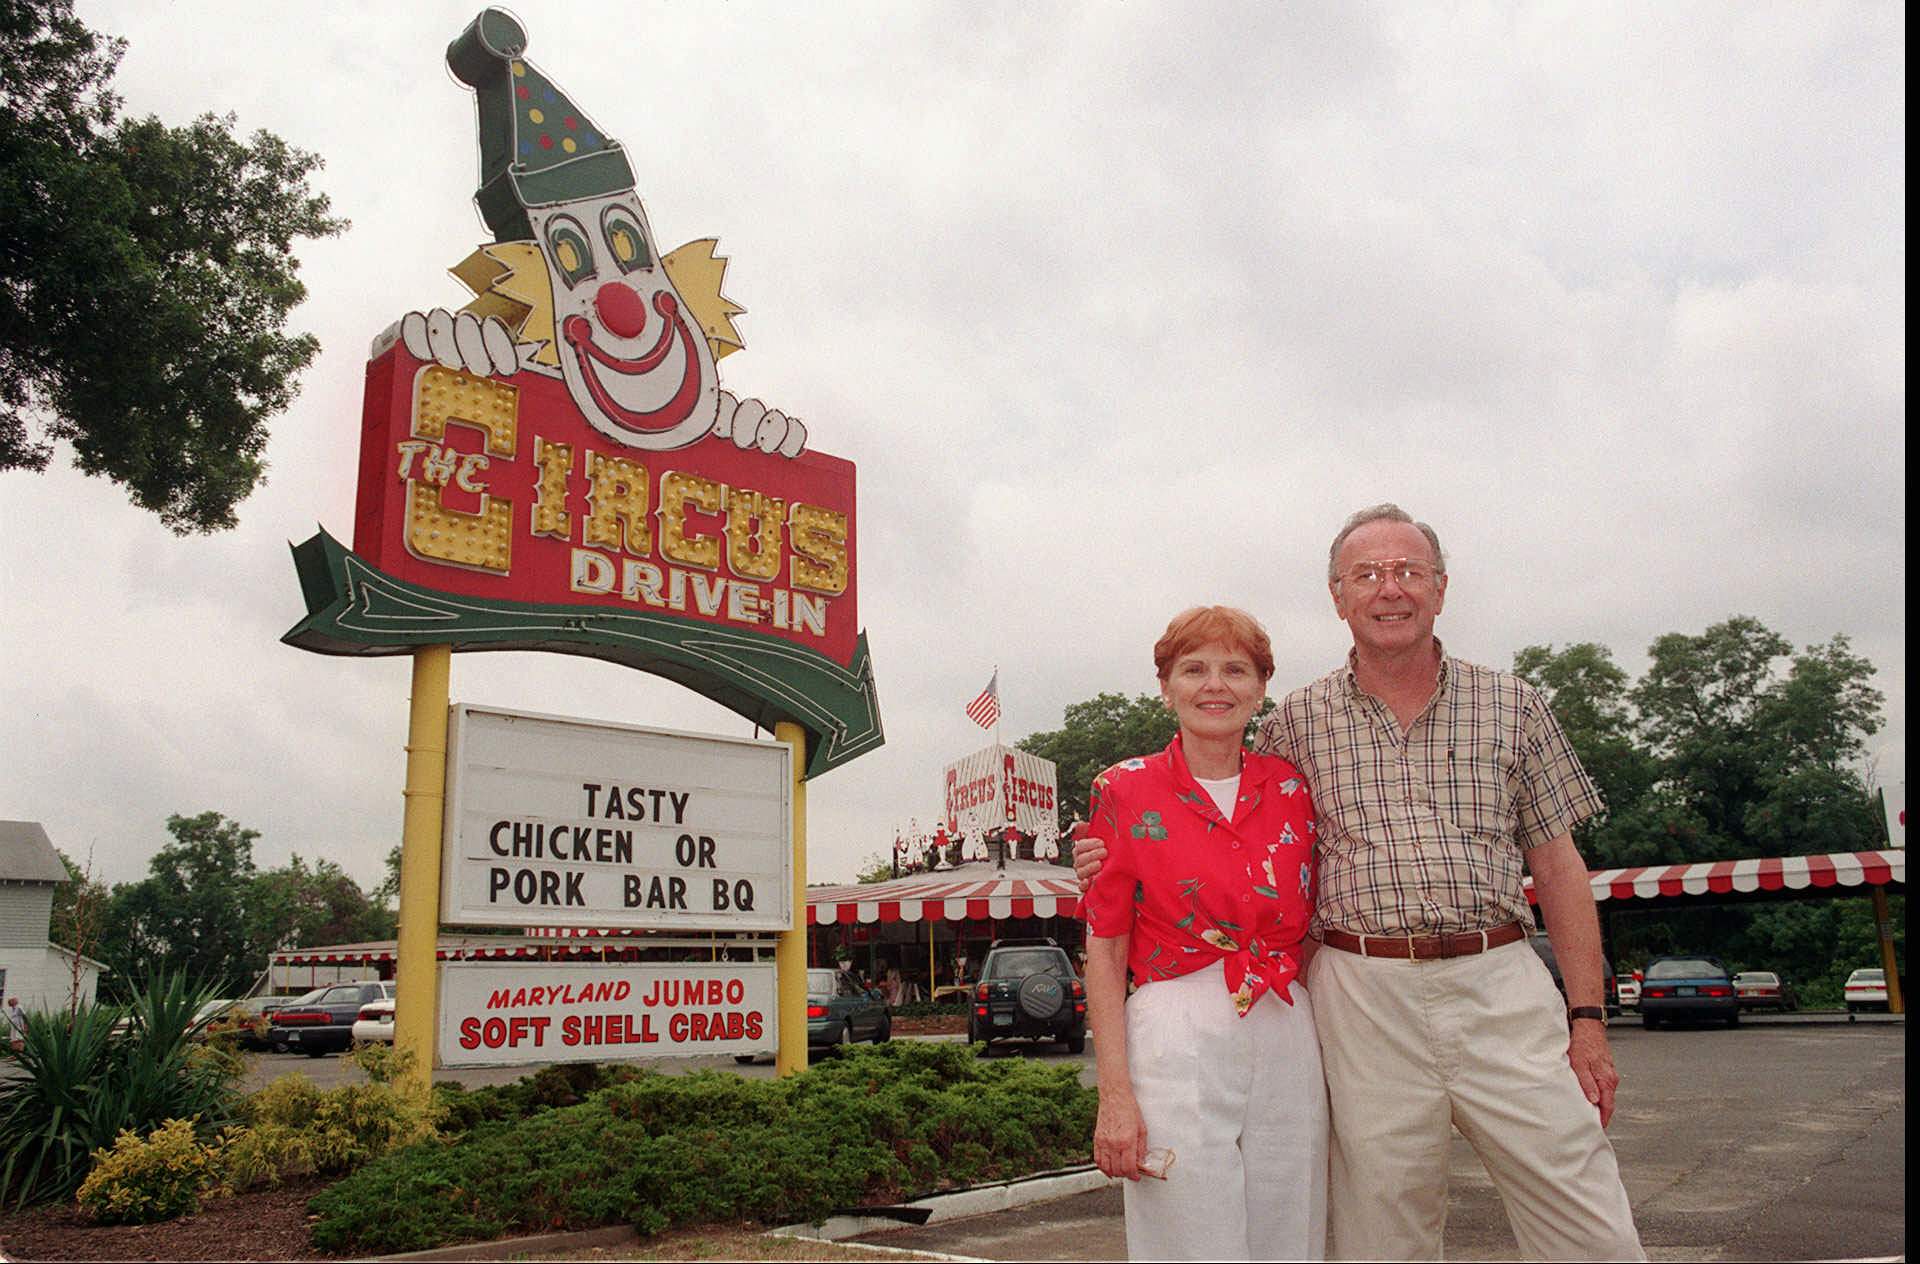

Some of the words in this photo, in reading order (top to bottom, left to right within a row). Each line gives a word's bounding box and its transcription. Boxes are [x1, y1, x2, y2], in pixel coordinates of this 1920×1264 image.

[398, 441, 489, 493] THE
[404, 364, 848, 596] CIRCUS
[583, 783, 690, 824] TASTY
[946, 769, 995, 832] CIRCUS
[1003, 754, 1053, 822] CIRCUS
[489, 821, 633, 864] CHICKEN
[675, 834, 717, 868] OR
[489, 867, 586, 906] PORK
[623, 874, 688, 909] BAR
[712, 879, 755, 912] BQ
[486, 980, 631, 1009] MARYLAND
[643, 978, 744, 1007] JUMBO
[459, 1016, 551, 1050] SOFT
[561, 1014, 659, 1046] SHELL
[669, 1010, 764, 1042] CRABS
